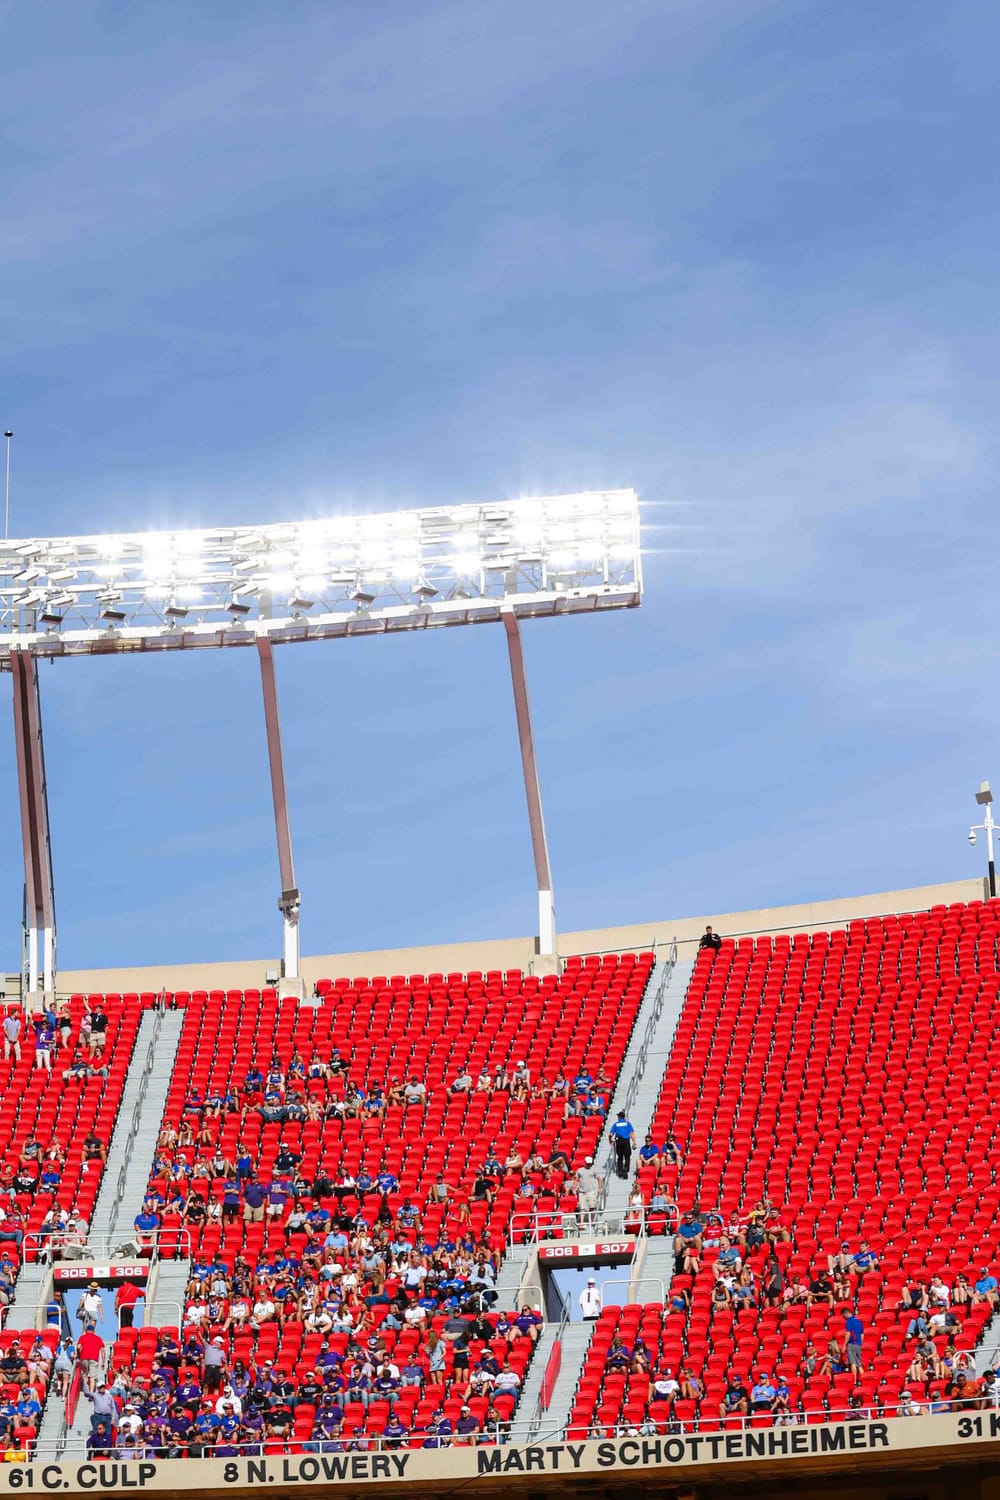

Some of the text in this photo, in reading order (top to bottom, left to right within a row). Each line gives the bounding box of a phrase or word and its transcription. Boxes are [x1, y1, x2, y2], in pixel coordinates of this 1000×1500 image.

[545, 1243, 629, 1256] 306 307
[60, 1267, 143, 1278] 305 306
[587, 1292, 591, 1303] 1
[958, 1416, 982, 1437] 31
[477, 1424, 890, 1474] MARTY SCHOTTENHEIMER
[9, 1464, 157, 1489] 61 C. CULP
[224, 1454, 410, 1483] 8 N. LOWERY
